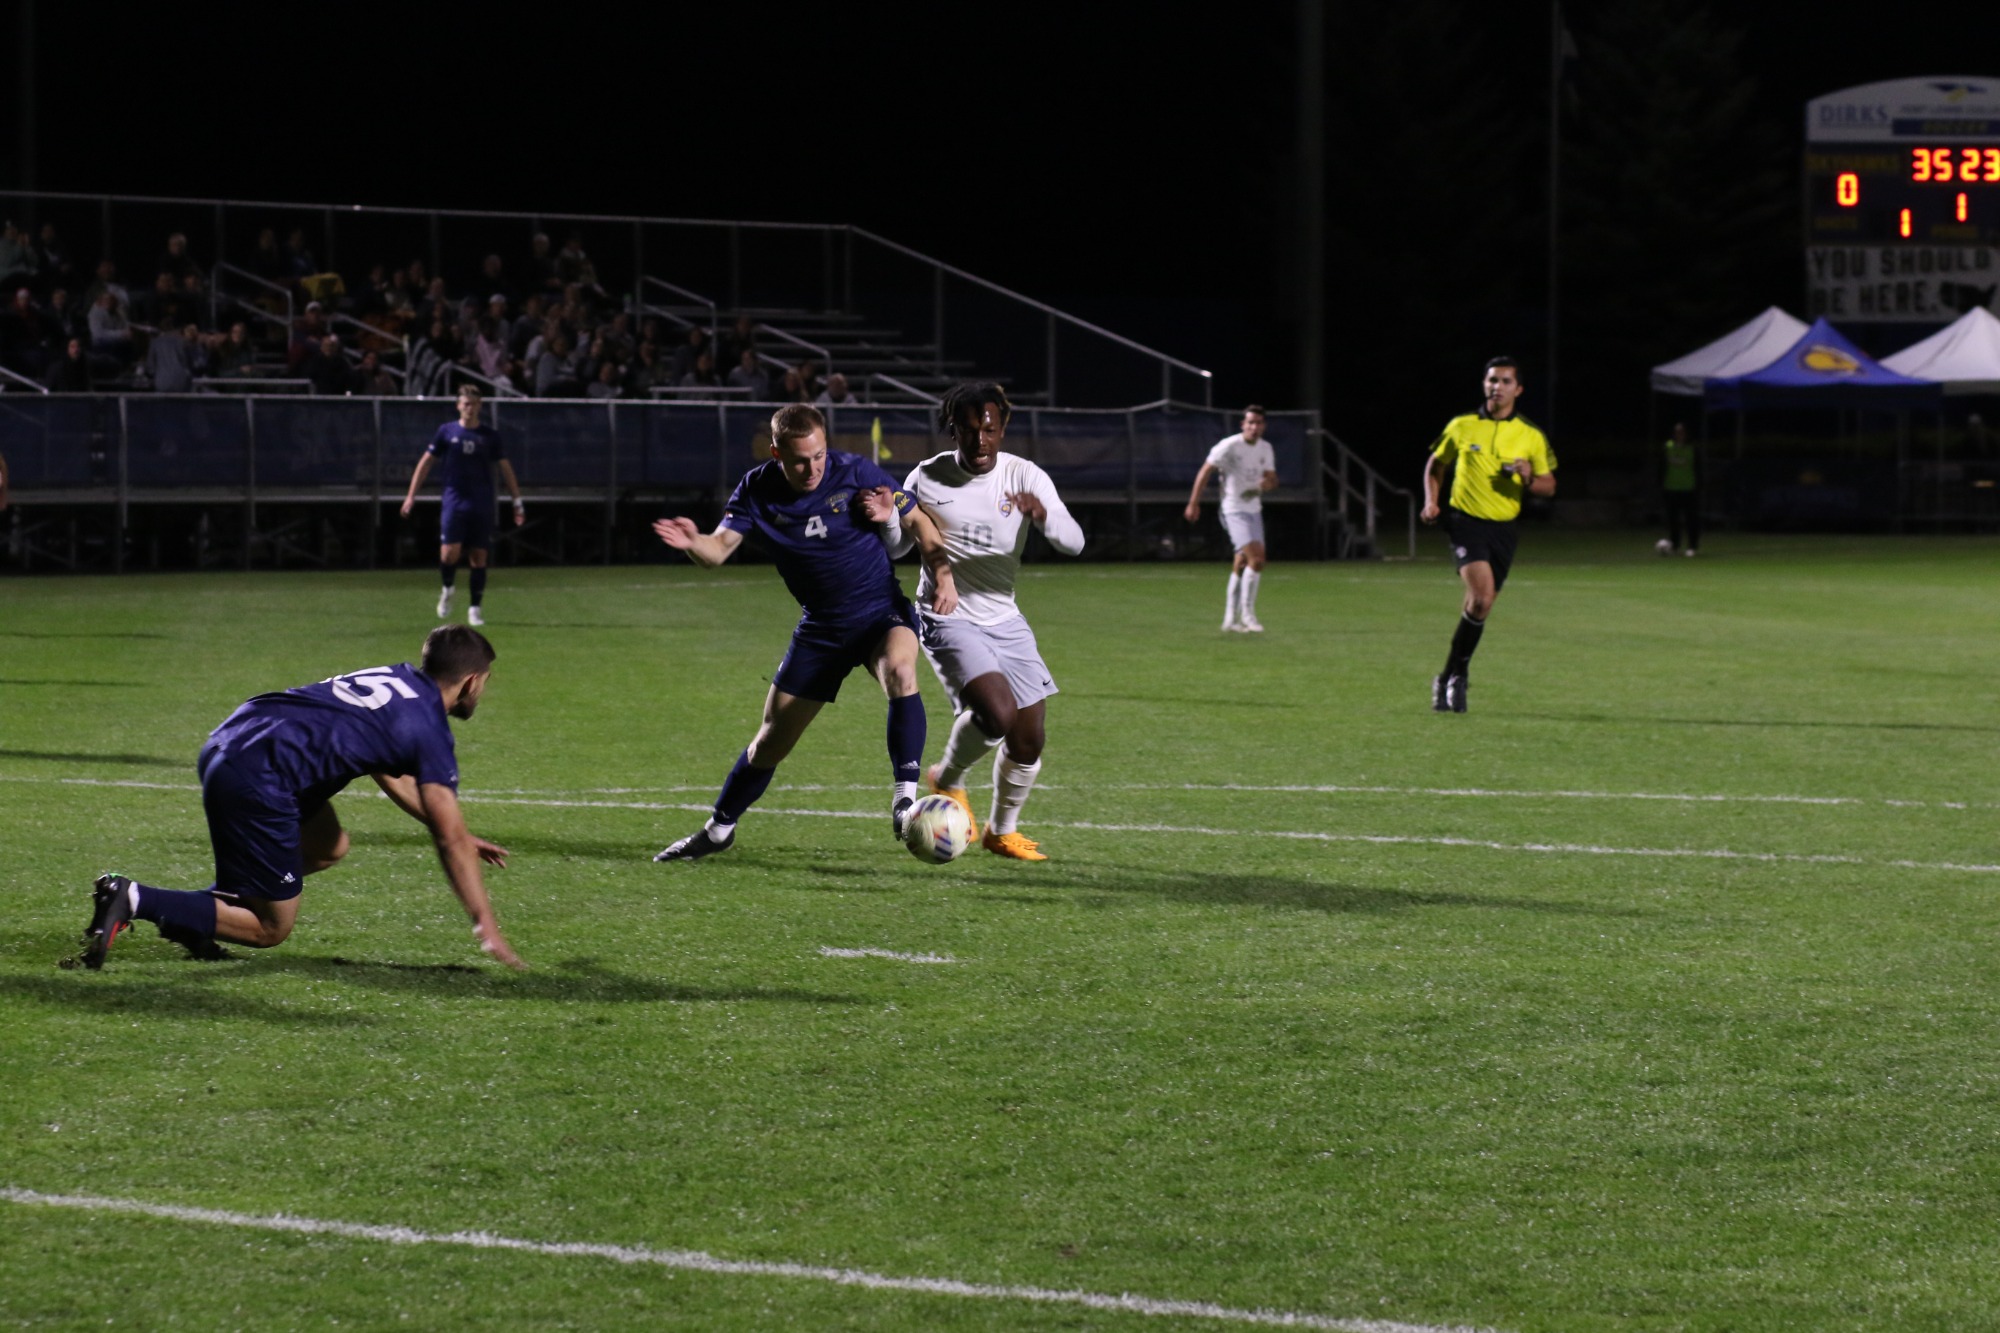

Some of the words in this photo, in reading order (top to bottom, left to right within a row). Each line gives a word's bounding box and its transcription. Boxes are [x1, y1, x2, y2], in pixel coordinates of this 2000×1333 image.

[1820, 104, 1888, 123] DIRKS
[1836, 172, 1860, 206] 0
[1812, 251, 1865, 279] YOU
[1881, 249, 1990, 274] SHOULD
[1814, 287, 1843, 312] BE
[804, 515, 828, 539] 4
[962, 522, 992, 548] 10
